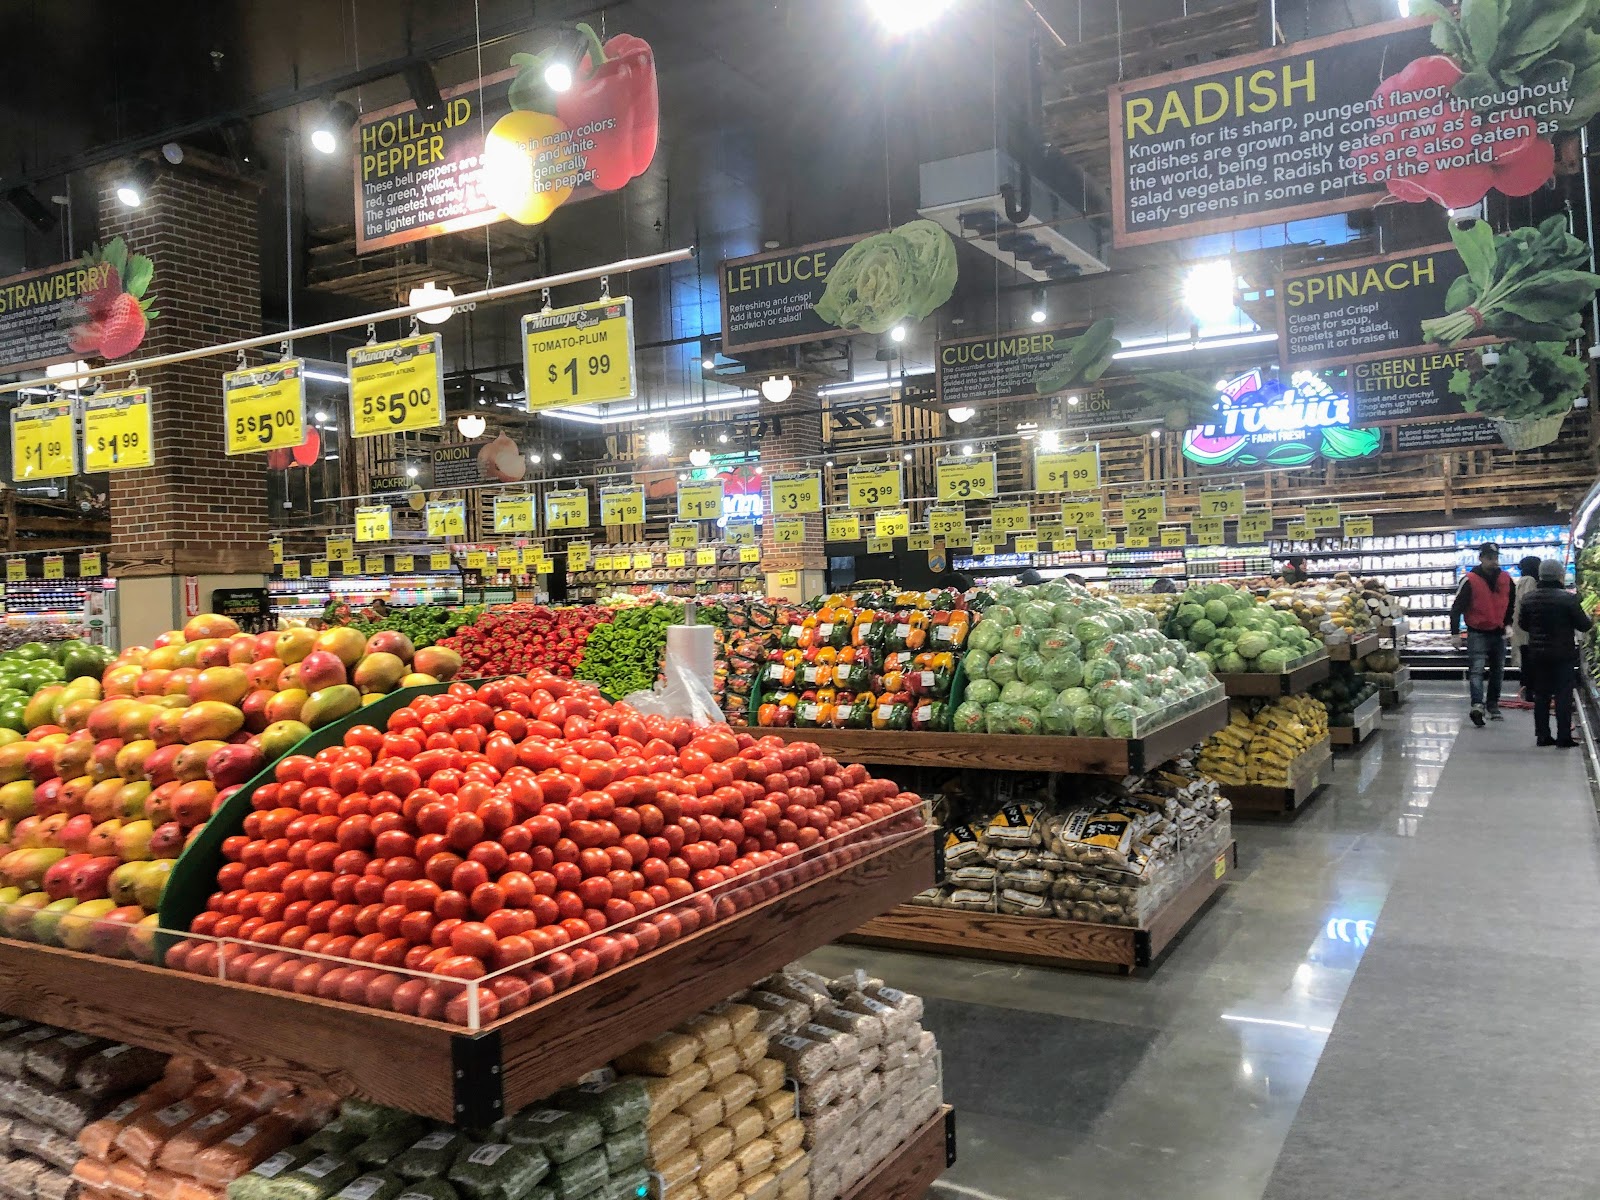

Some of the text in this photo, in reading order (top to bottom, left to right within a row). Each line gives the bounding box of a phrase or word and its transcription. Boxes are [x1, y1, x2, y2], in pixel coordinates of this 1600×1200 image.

[1126, 59, 1316, 140] RADISH
[529, 138, 538, 150] in
[542, 128, 574, 147] many
[576, 117, 617, 137] colors:
[1129, 84, 1450, 159] Known for its sharp, pungent flavor,
[1129, 76, 1569, 175] radishes are grown and consumed throughout
[539, 148, 560, 163] and
[562, 139, 598, 156] white.
[1129, 97, 1575, 192] the world, being mostly eaten raw as a crunchy
[363, 135, 445, 181] PEPPER
[533, 155, 588, 180] generally
[1130, 118, 1559, 208] salad vegetable. Radish tops are also eaten as
[365, 178, 393, 195] These
[395, 171, 414, 187] bell
[415, 161, 458, 185] peppers
[533, 167, 600, 193] the pepper.
[1131, 147, 1499, 224] leafy-greens in some parts of the world.
[365, 194, 385, 209] red,
[387, 187, 419, 206] green,
[421, 177, 457, 196] yellow,
[365, 187, 465, 222] The sweetest variety
[366, 201, 467, 236] the lighter the color,
[727, 252, 827, 294] LETTUCE
[1286, 257, 1435, 307] SPINACH
[0, 263, 111, 313] STRAWBERRY
[729, 291, 812, 314] Refreshing and crisp!
[729, 301, 814, 323] Add it to your favorite
[1288, 301, 1379, 325] Clean and Crisp!
[532, 310, 588, 329] Manager's
[730, 312, 802, 332] sandwich or salad!
[1289, 315, 1371, 334] Great for soup,
[532, 331, 608, 354] TOMATO-PLUM
[1290, 320, 1392, 344] omelets and salad.
[1291, 330, 1399, 355] Steam it or braise it!
[942, 334, 1055, 365] CUCUMBER
[954, 362, 986, 372] cucumber
[960, 371, 978, 380] many
[1023, 362, 1038, 371] They
[1355, 352, 1465, 378] GREEN LEAF
[943, 378, 965, 387] divided
[965, 376, 978, 384] into
[1356, 371, 1431, 393] LETTUCE
[1067, 399, 1110, 413] MELON
[1382, 393, 1397, 402] and
[1398, 389, 1435, 401] crunchy!
[1394, 397, 1439, 409] up for your
[1251, 431, 1278, 444] FARM
[434, 447, 471, 462] ONION
[596, 466, 617, 475] YAM
[372, 476, 415, 490] JACKFRUIT
